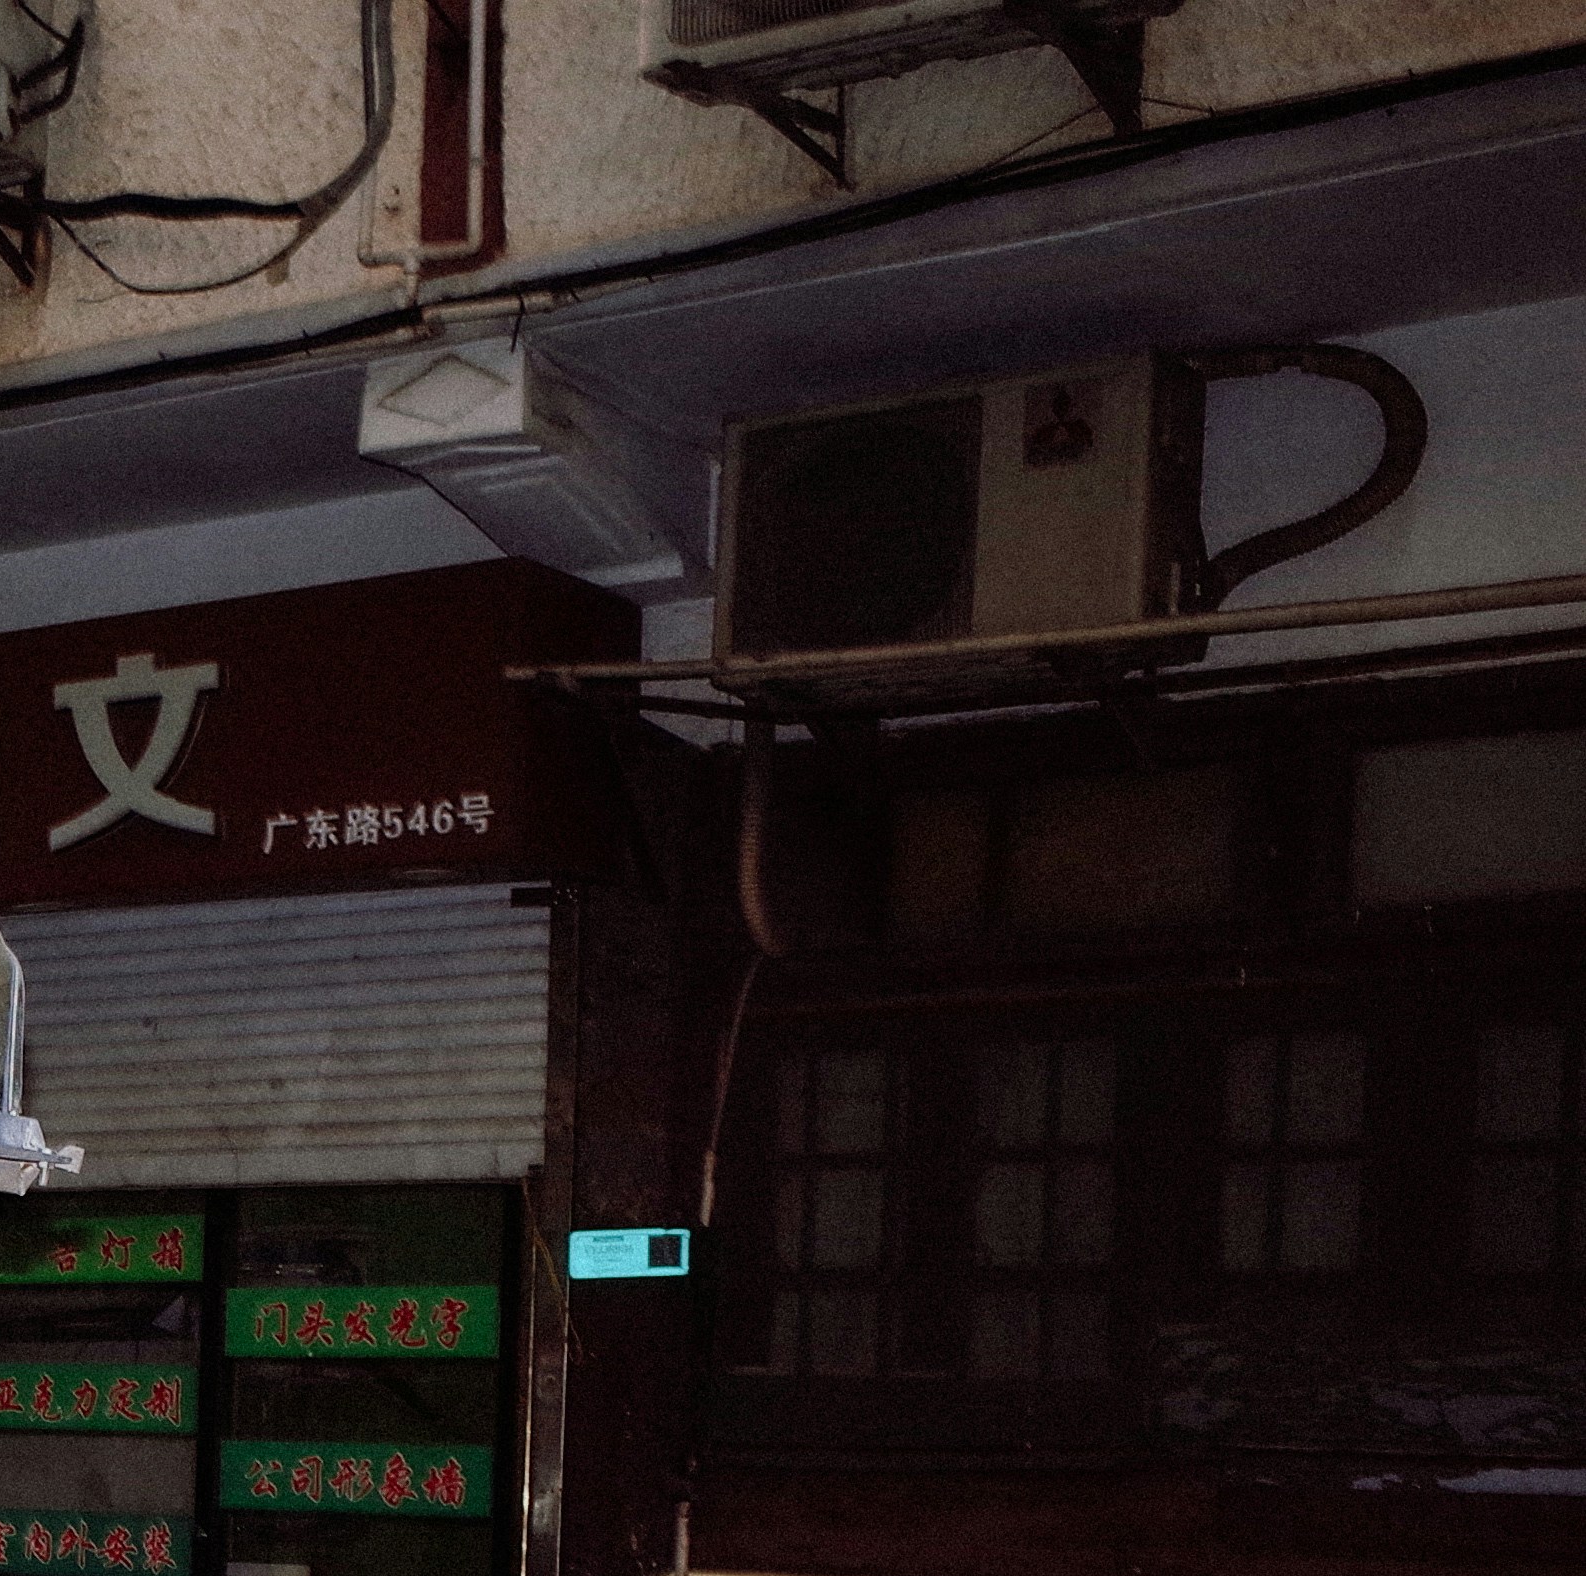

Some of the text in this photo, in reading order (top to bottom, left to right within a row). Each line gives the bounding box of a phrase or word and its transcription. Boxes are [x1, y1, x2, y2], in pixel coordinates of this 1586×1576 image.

[47, 652, 220, 853] 文
[261, 791, 495, 855] 广东路546号
[251, 1297, 469, 1351] 门头发光字
[244, 1451, 468, 1510] 公司形象墙
